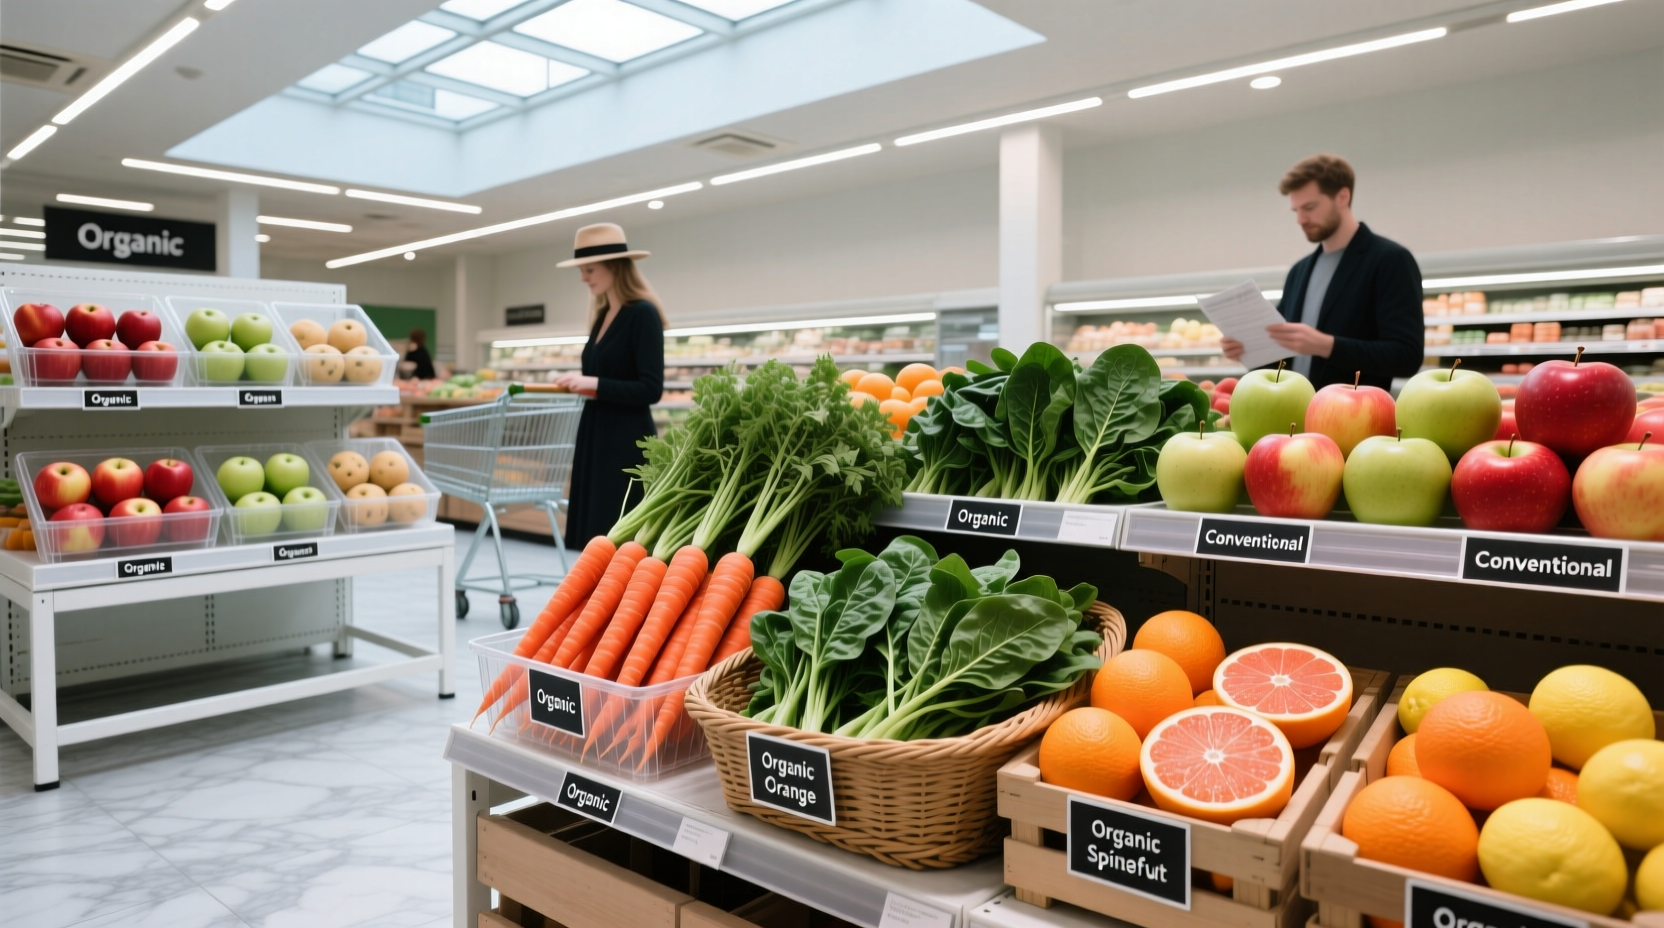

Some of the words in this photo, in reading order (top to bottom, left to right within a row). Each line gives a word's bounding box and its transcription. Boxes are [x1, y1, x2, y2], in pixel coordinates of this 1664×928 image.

[78, 223, 183, 258] Organic
[957, 508, 1009, 530] Organic
[1205, 529, 1304, 551] Conventional
[1475, 550, 1613, 578] Conventional
[536, 688, 575, 714] Organic
[762, 752, 815, 780] Organic
[566, 782, 610, 809] Organic
[765, 777, 816, 806] Orange
[1091, 819, 1161, 854] Organic
